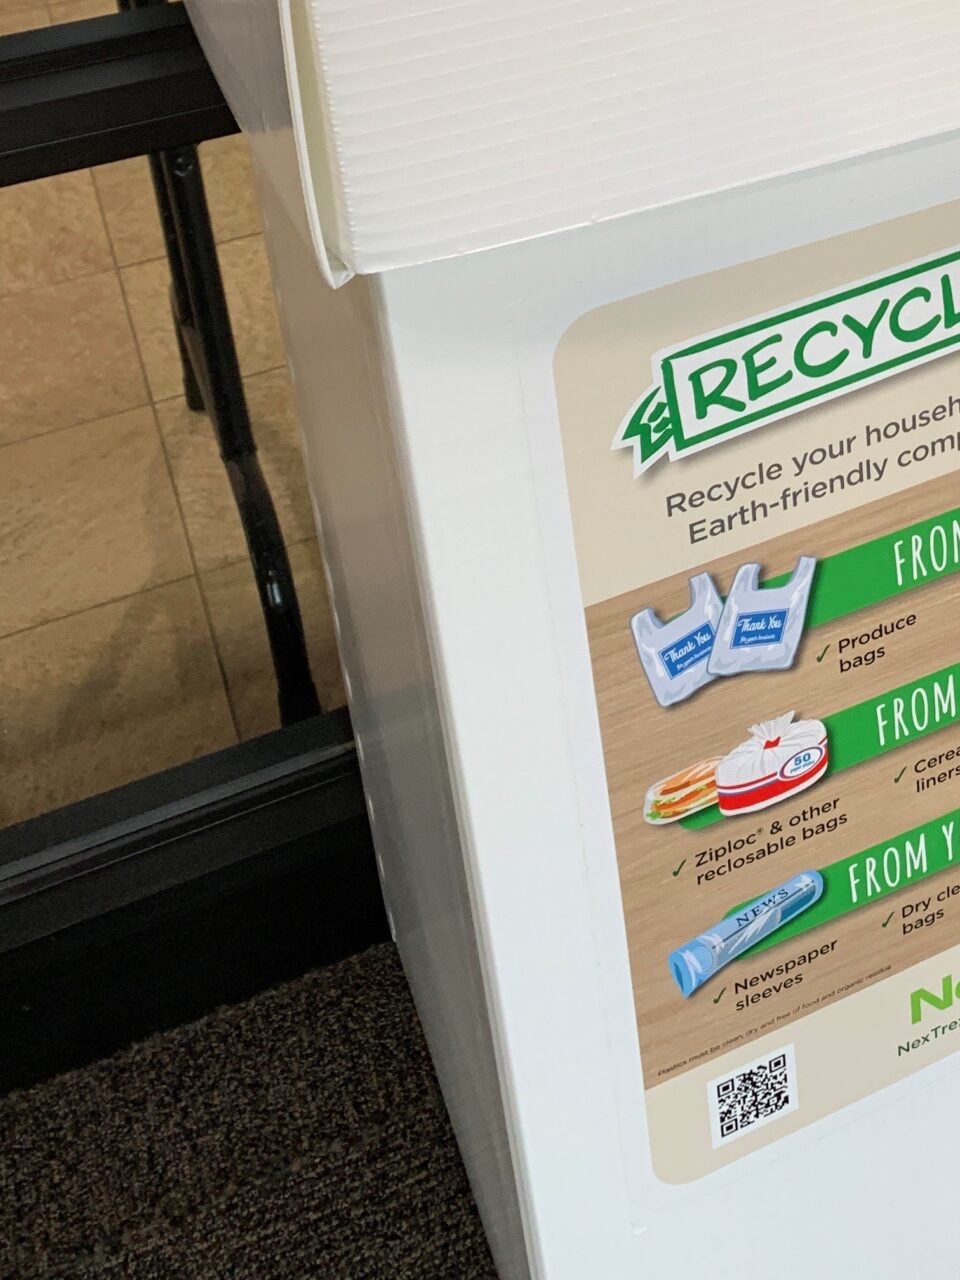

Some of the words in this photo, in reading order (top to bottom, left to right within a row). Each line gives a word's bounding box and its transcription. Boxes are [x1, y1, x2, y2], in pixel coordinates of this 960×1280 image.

[666, 462, 783, 518] Recycle
[791, 435, 857, 479] your
[689, 458, 888, 545] Earth-friendly
[738, 618, 767, 633] Thank
[767, 615, 782, 630] You
[838, 613, 918, 654] Produce
[663, 640, 696, 663] Thank
[694, 631, 712, 646] You
[839, 645, 886, 674] bags
[876, 674, 957, 746] FROM
[794, 752, 811, 766] 50
[769, 820, 783, 835] &
[788, 797, 841, 827] other
[696, 832, 796, 886] reclosable
[802, 813, 849, 841] bags
[848, 833, 928, 904] FROM
[736, 888, 789, 928] NEWS
[901, 897, 931, 919] Dry
[902, 907, 945, 936] bags
[734, 939, 839, 995] Newspaper
[710, 1044, 721, 1053] be
[760, 1018, 775, 1030] and
[777, 1012, 791, 1022] free
[793, 1006, 801, 1015] of
[802, 998, 820, 1010] food
[821, 989, 836, 1001] and
[865, 965, 892, 981] residue
[735, 974, 804, 1012] sleeves
